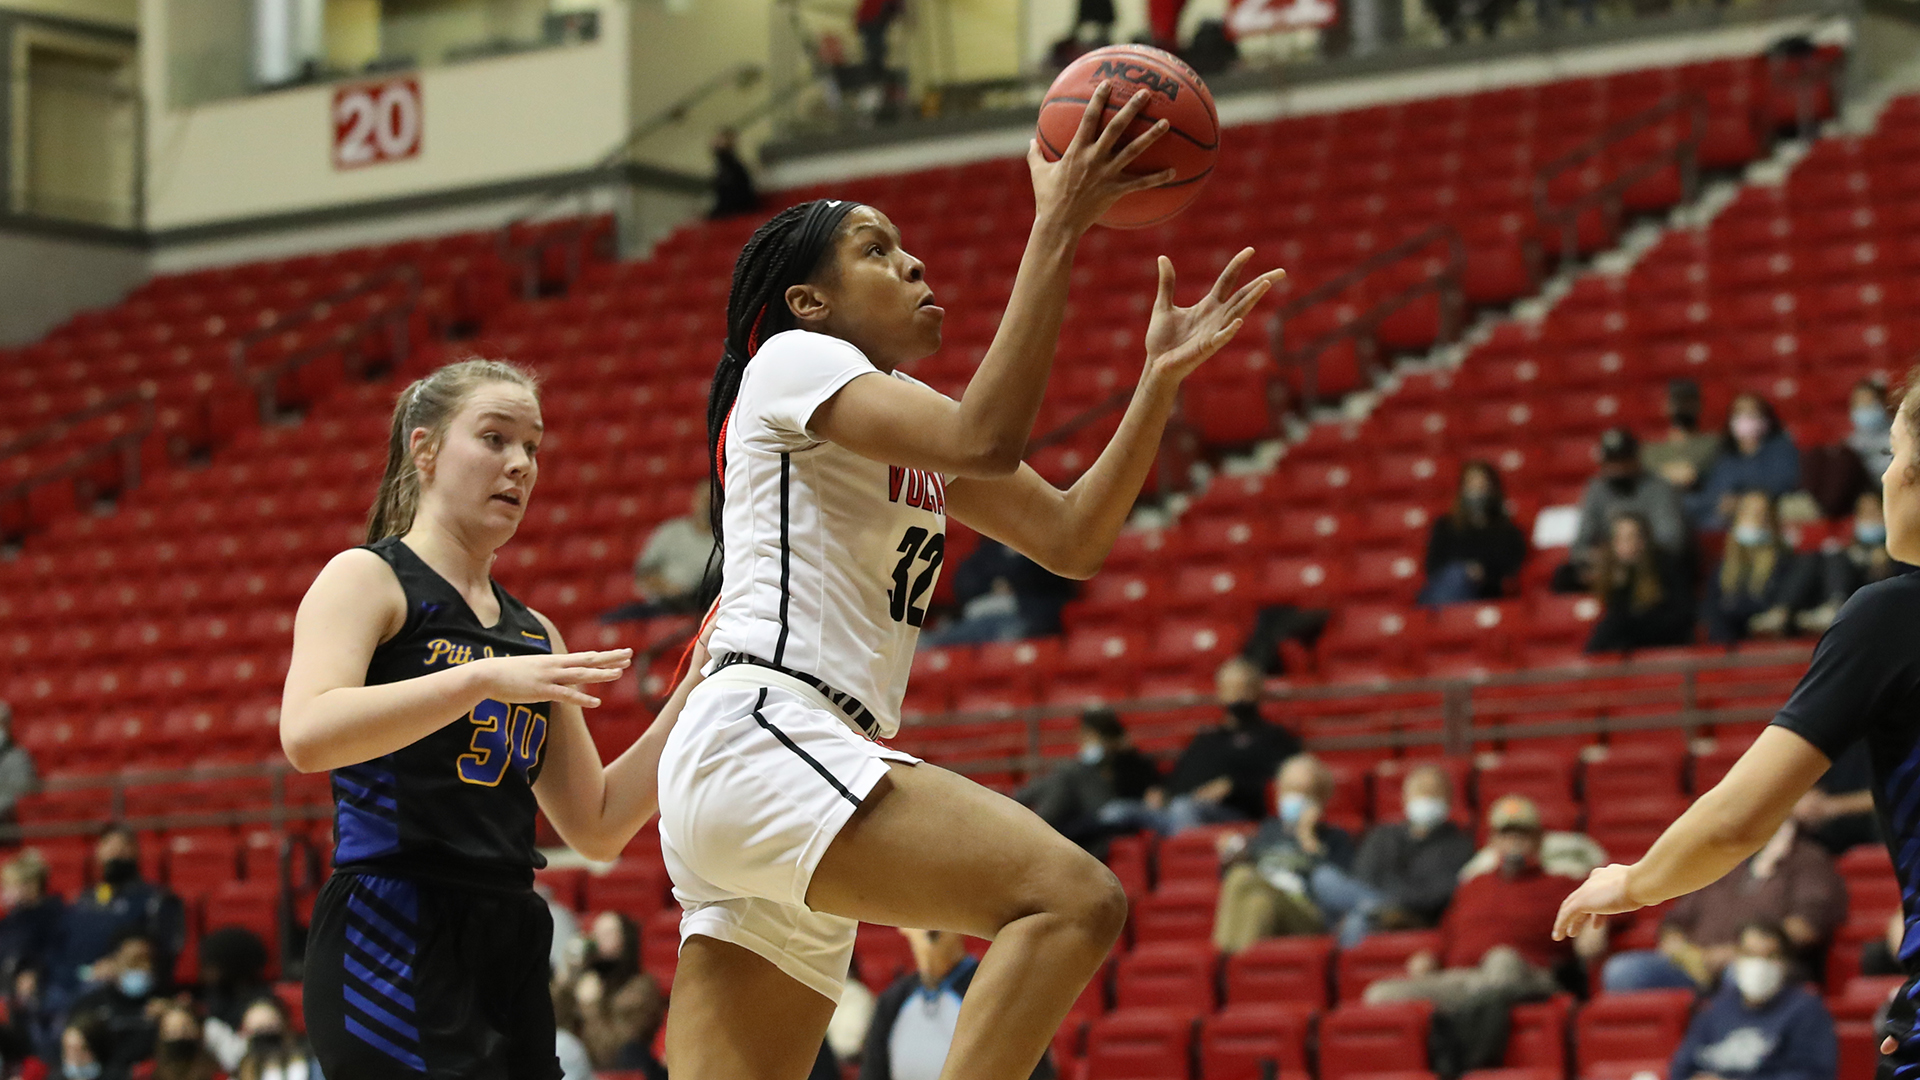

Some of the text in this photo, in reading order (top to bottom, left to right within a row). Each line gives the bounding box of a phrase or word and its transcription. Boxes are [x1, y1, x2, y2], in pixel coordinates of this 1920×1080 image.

[1092, 60, 1180, 102] NCAA
[337, 87, 416, 161] 20
[887, 525, 945, 628] 32
[423, 638, 474, 665] Pitt
[456, 697, 547, 788] 34
